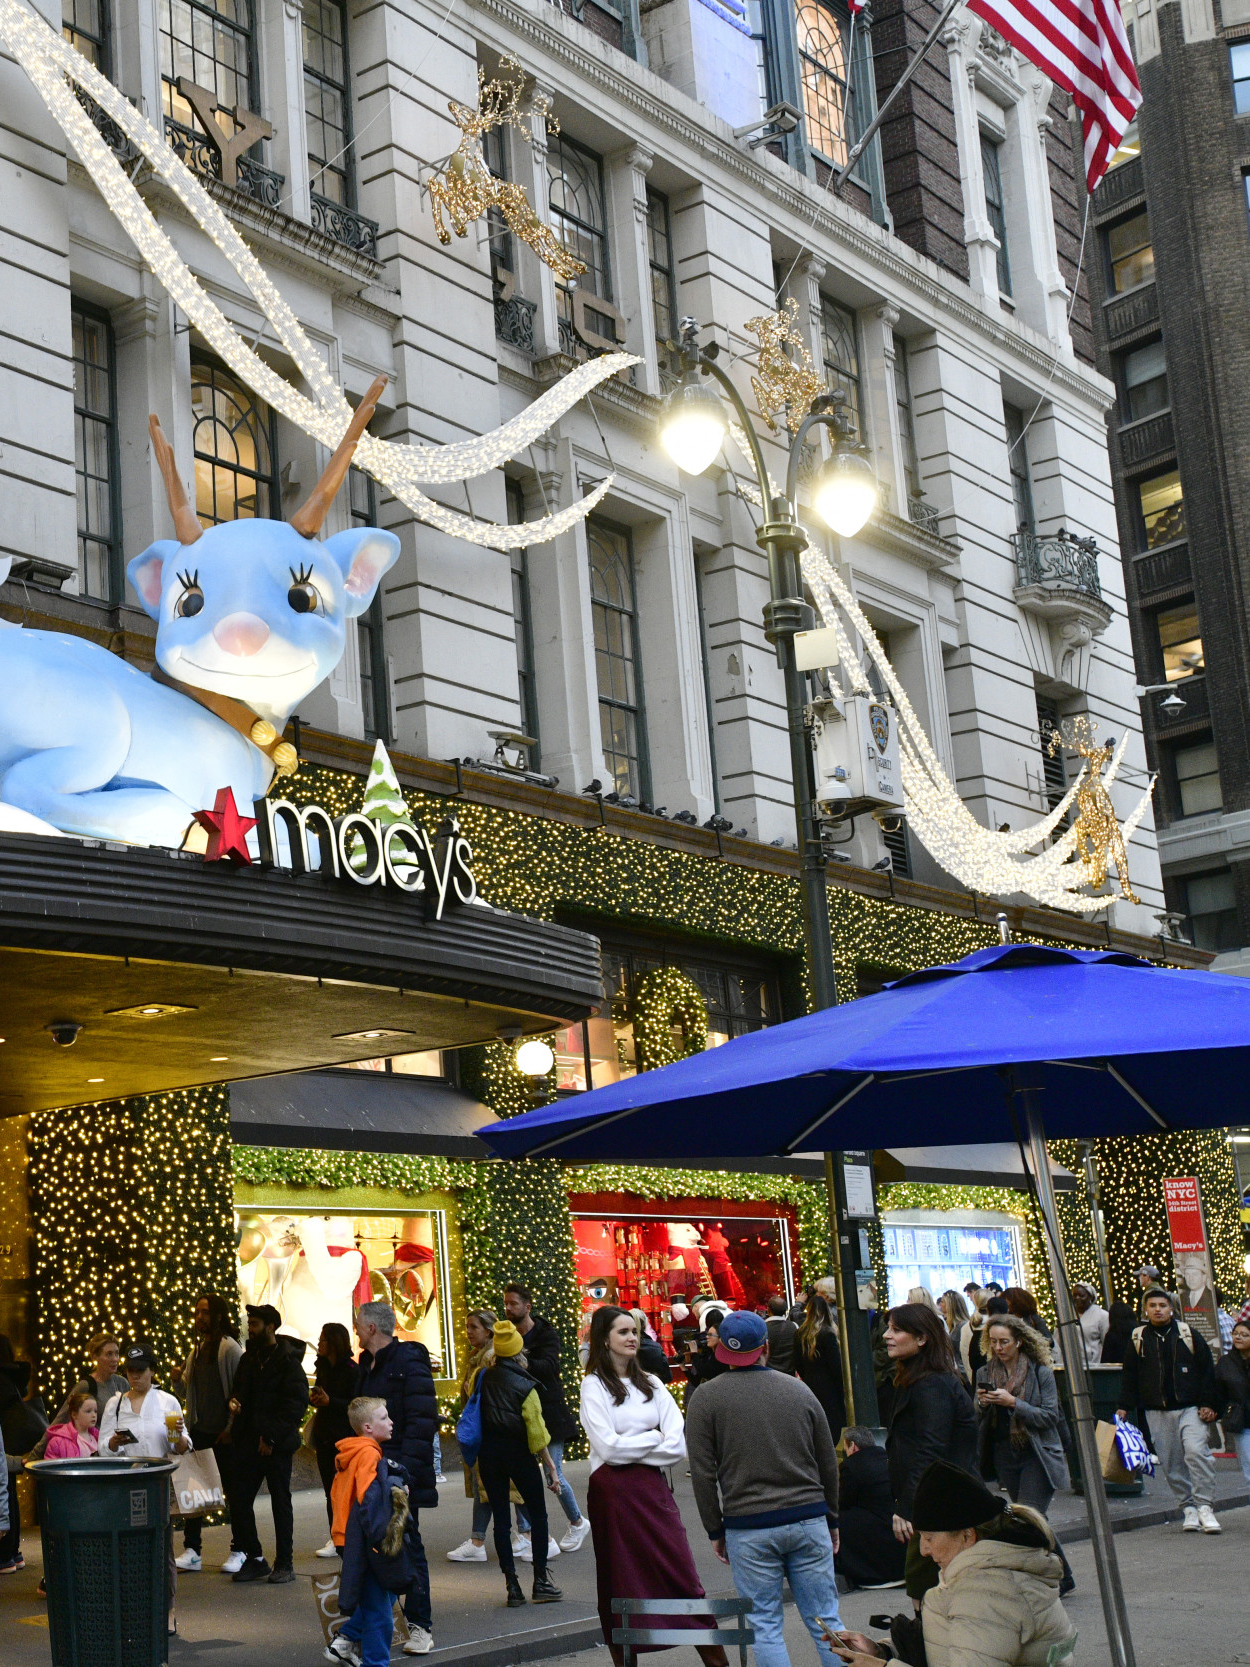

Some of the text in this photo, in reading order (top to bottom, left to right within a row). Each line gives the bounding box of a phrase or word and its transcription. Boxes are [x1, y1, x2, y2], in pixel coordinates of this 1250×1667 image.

[878, 757, 892, 771] ECURITY
[256, 797, 478, 921] macy's
[1165, 1181, 1194, 1189] know
[1167, 1189, 1196, 1199] NYC
[1169, 1205, 1198, 1213] district
[1174, 1242, 1203, 1250] Macy's
[167, 1429, 180, 1438] CA
[180, 1487, 225, 1510] CAVA
